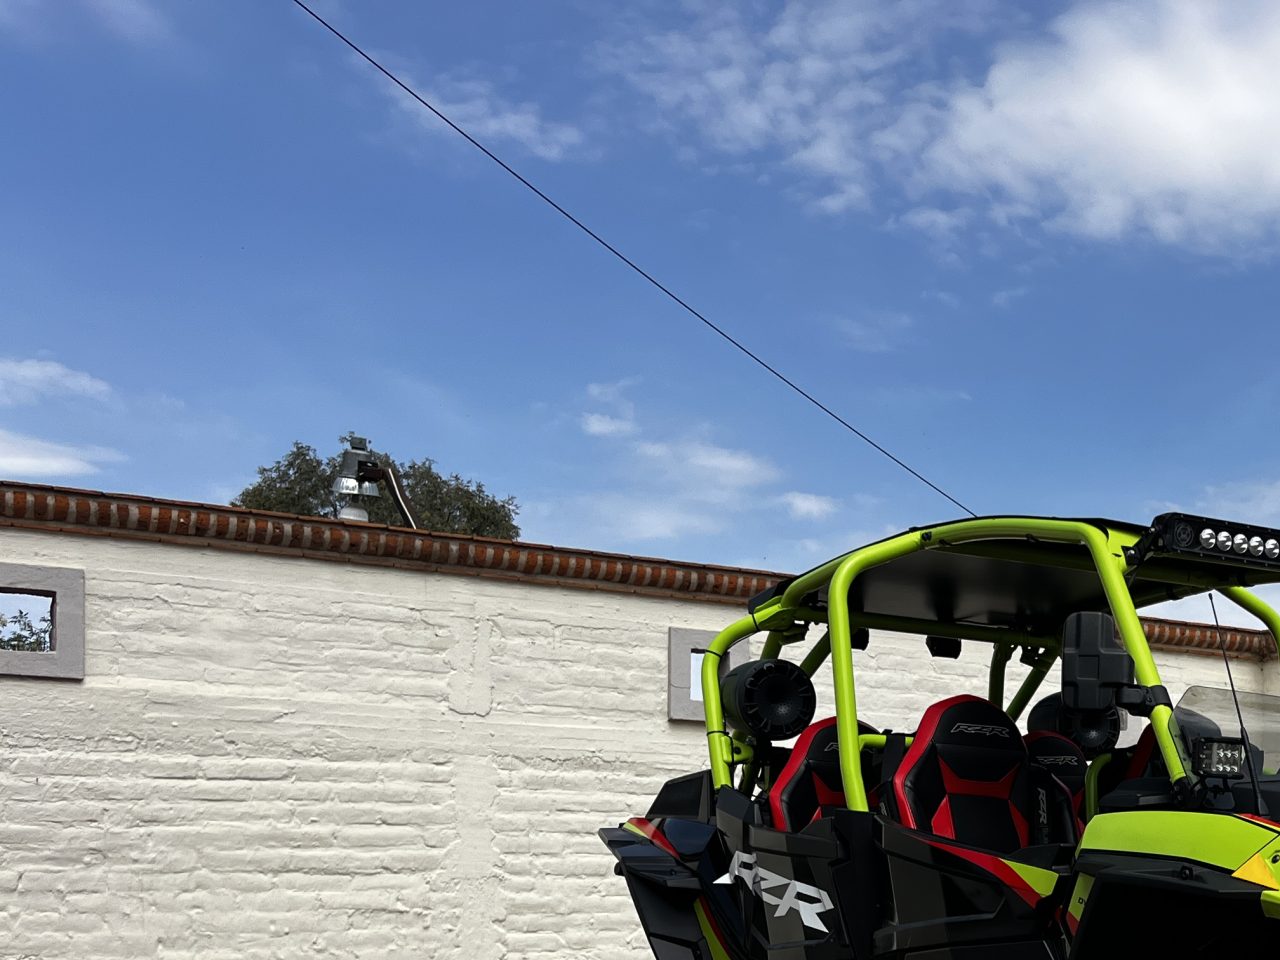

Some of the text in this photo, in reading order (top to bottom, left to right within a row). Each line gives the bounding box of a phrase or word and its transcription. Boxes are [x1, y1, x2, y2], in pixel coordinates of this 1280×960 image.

[951, 722, 1010, 738] RZR
[1037, 787, 1048, 825] RZR
[713, 850, 835, 933] RZR
